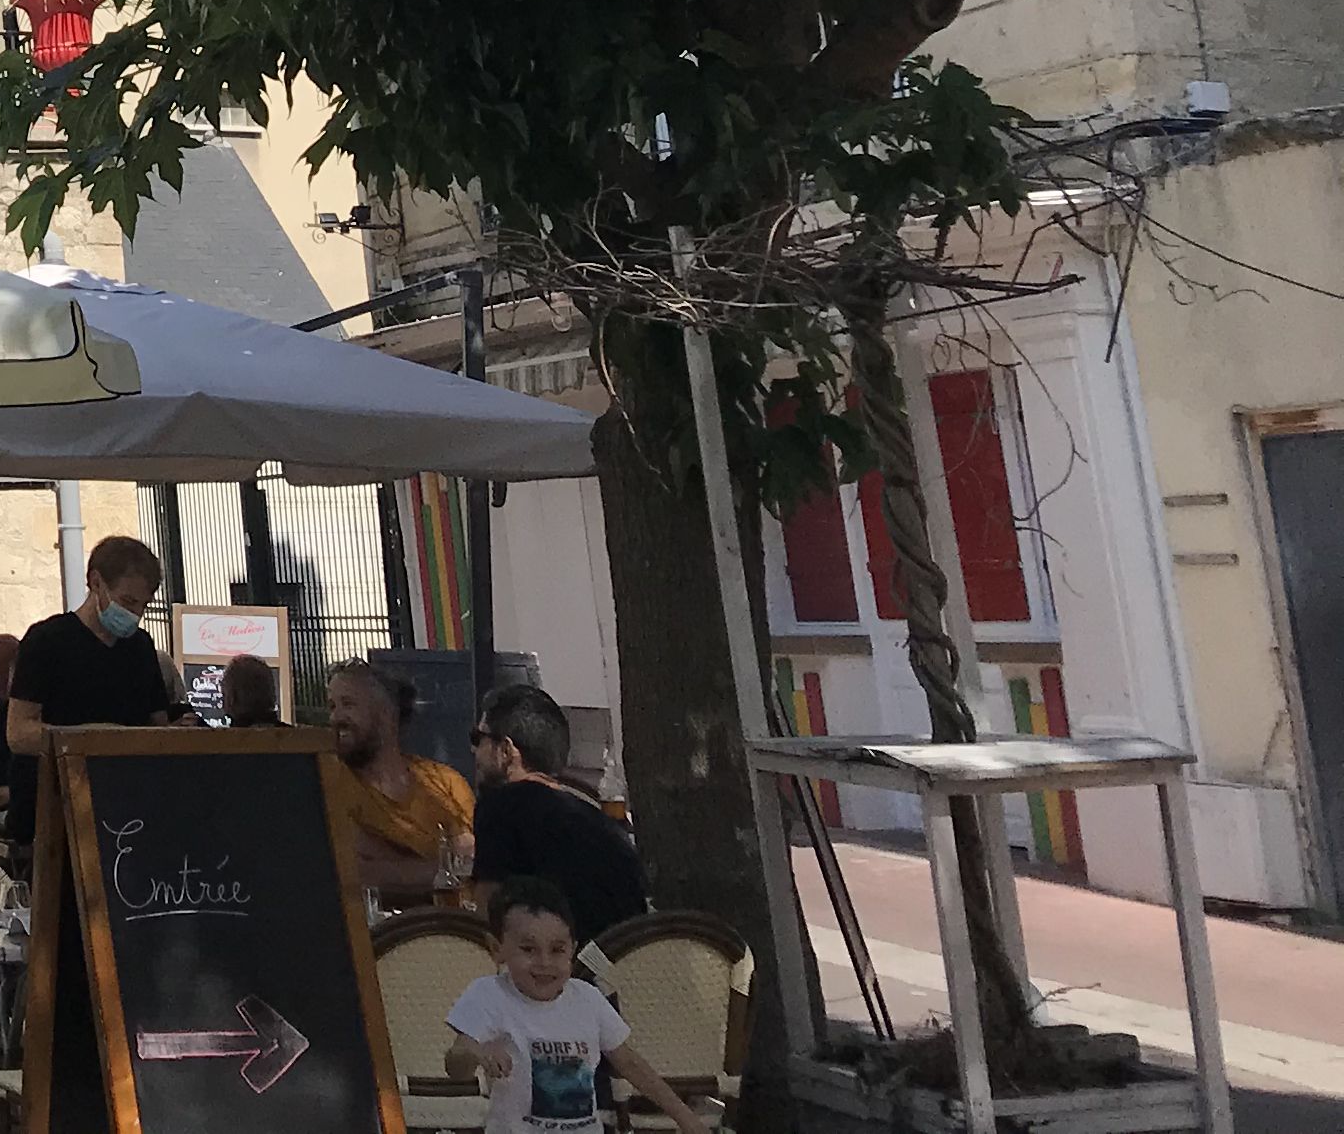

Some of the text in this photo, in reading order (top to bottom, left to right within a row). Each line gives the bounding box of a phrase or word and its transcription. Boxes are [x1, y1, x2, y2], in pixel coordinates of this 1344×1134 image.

[103, 819, 251, 909] Entrée
[531, 1041, 588, 1054] SURF IS
